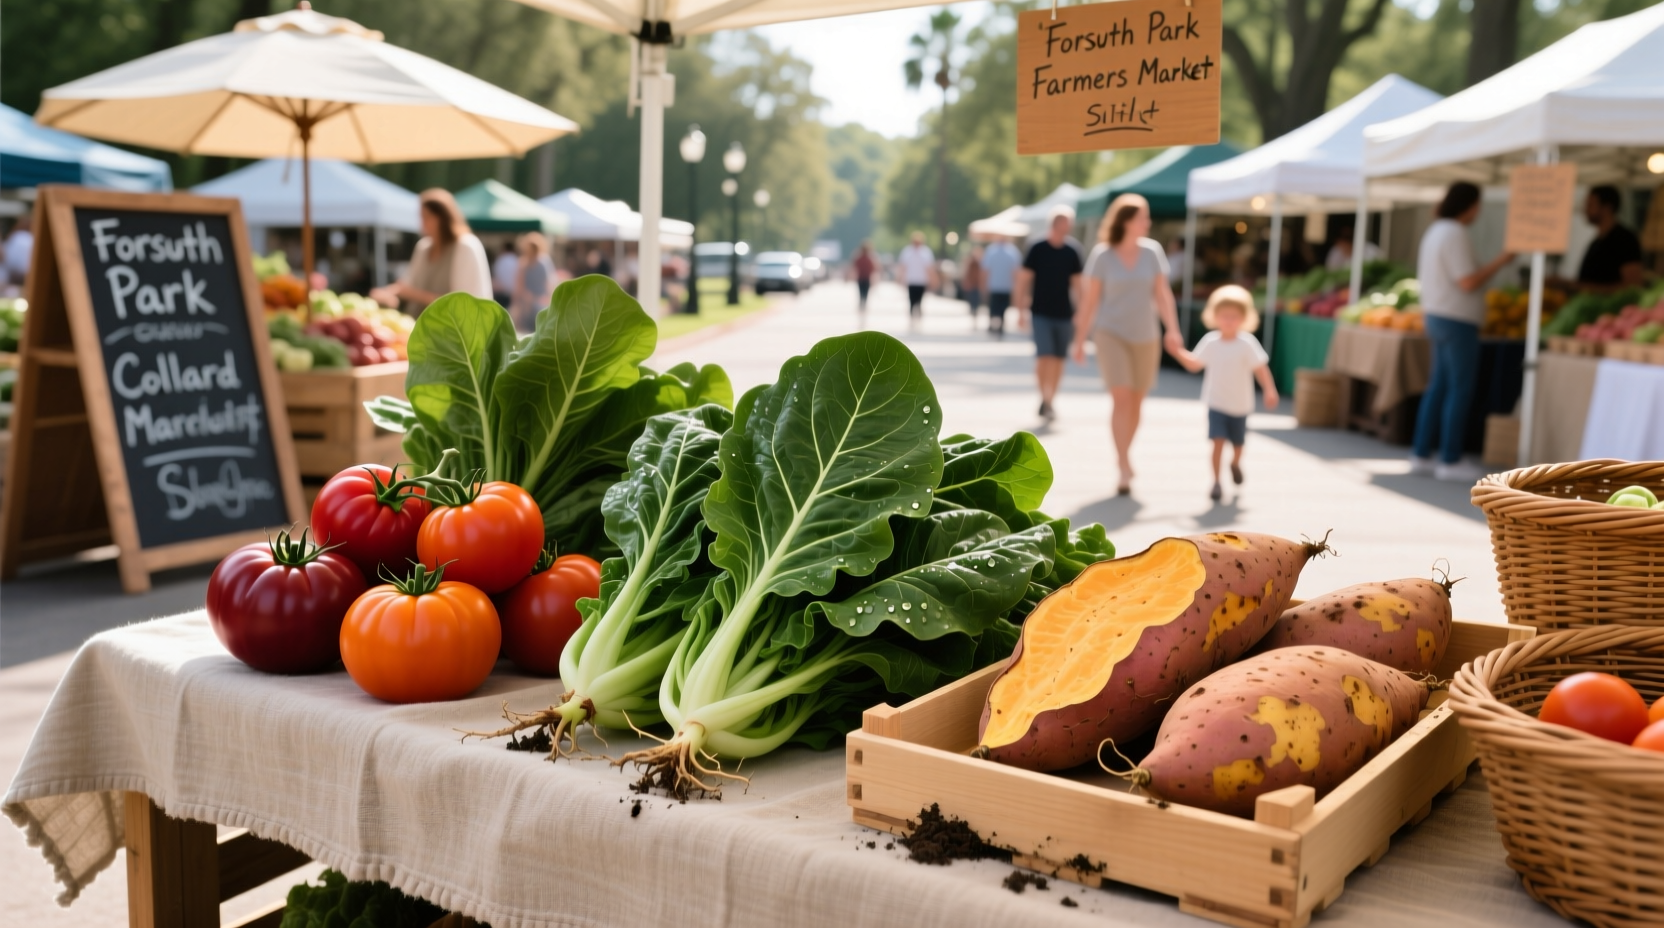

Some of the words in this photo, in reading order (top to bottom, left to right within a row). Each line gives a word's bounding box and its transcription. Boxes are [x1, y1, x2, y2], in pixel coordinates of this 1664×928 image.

[1147, 10, 1200, 44] Park
[1032, 64, 1128, 99] Farmers
[1137, 55, 1214, 86] Market
[90, 217, 224, 264] Forsuth
[105, 264, 218, 320] Park
[112, 349, 242, 400] Collard
